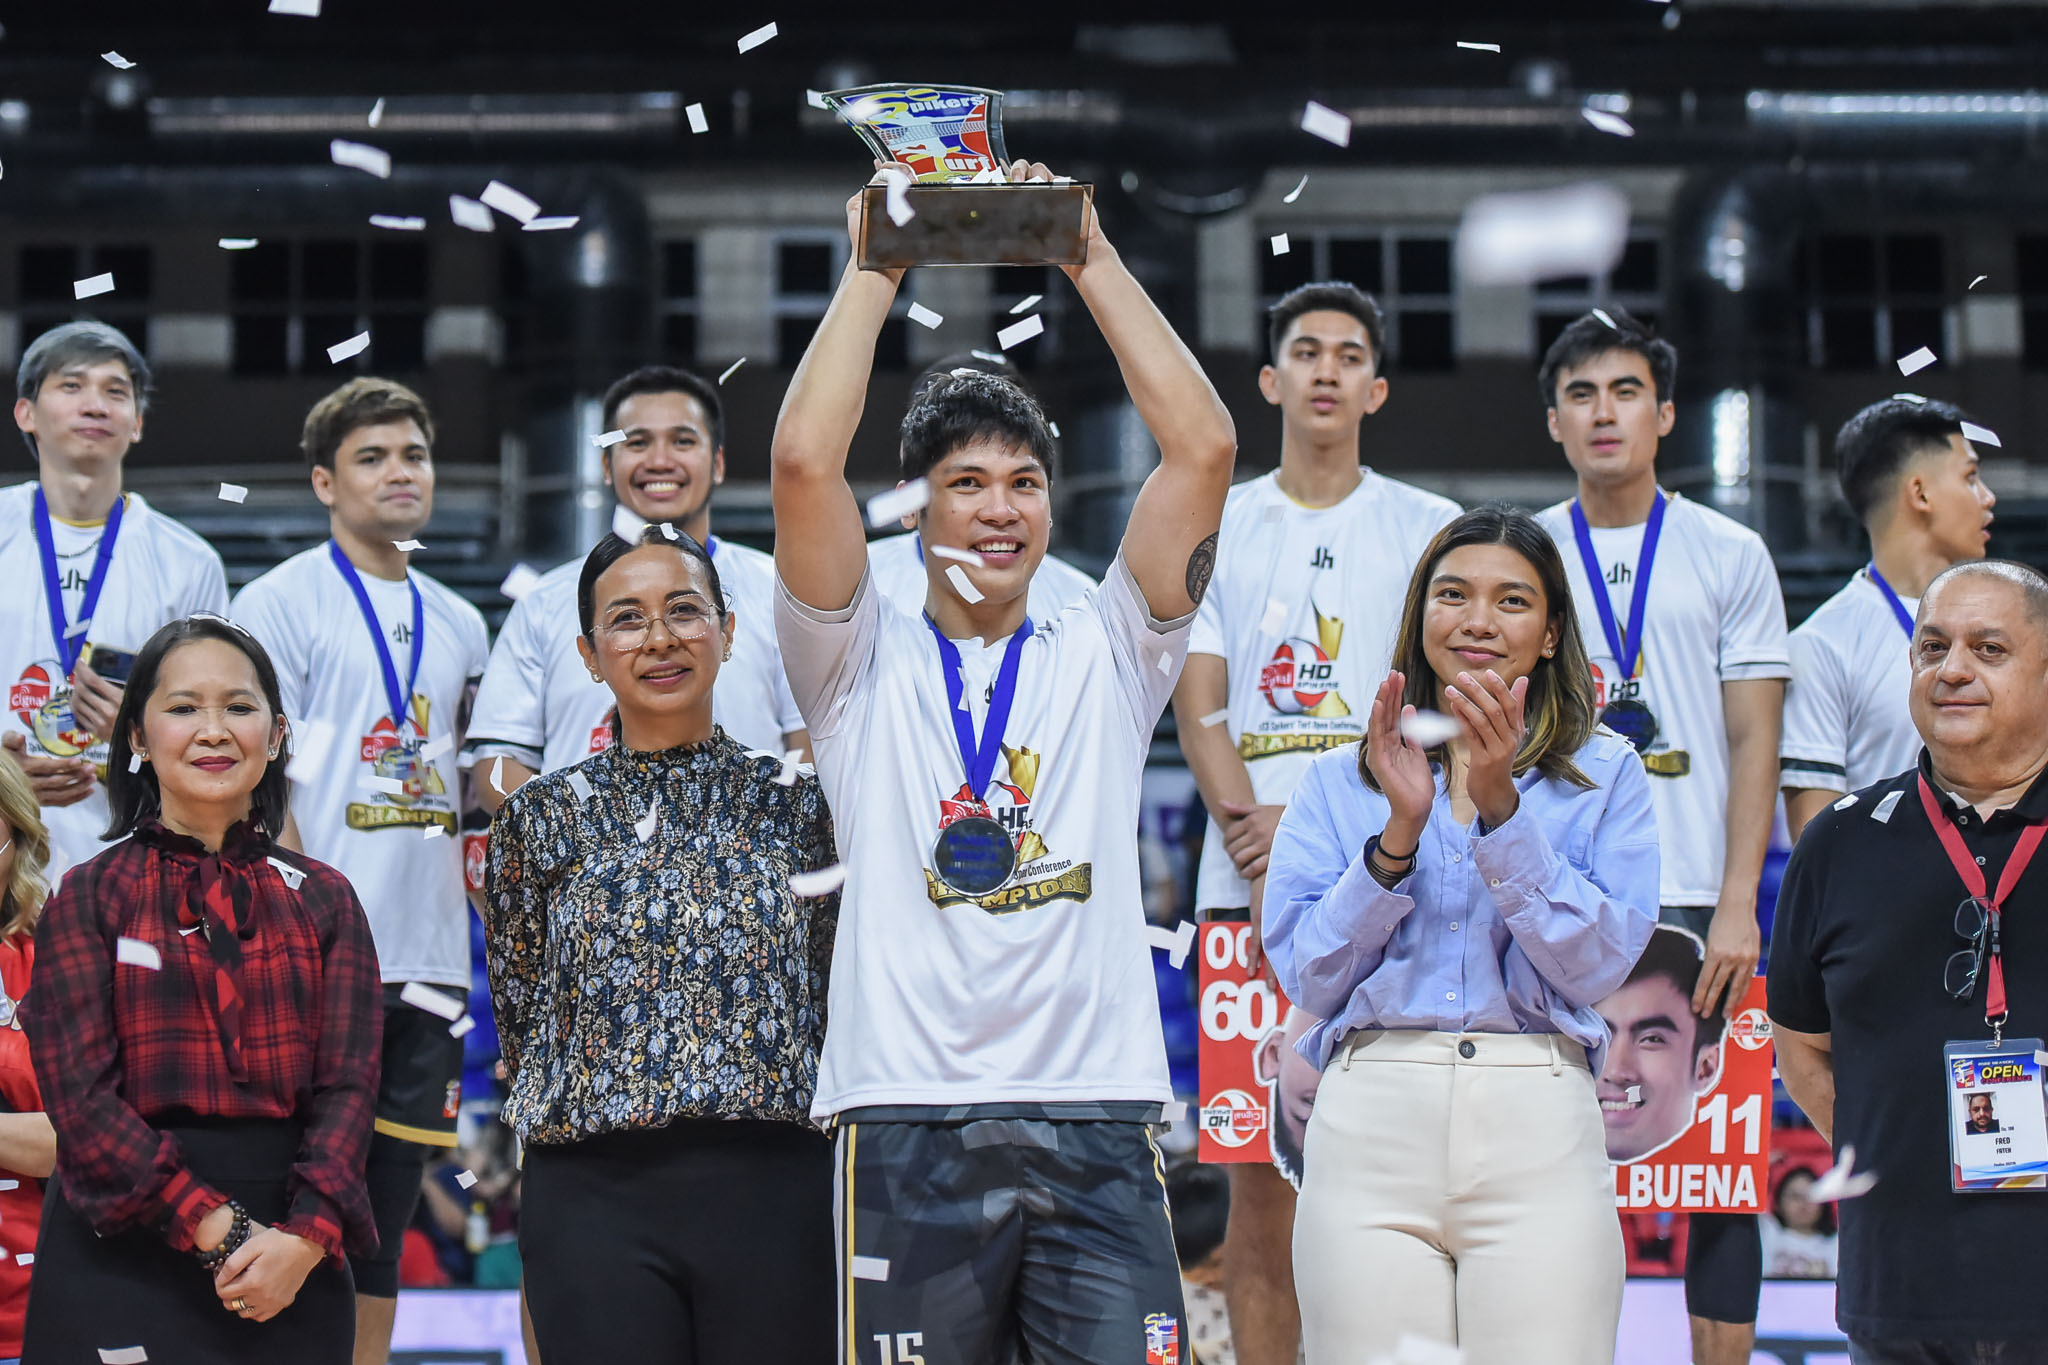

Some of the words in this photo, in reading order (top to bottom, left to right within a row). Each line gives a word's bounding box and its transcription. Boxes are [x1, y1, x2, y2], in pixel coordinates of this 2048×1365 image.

[1299, 664, 1332, 680] HD
[1981, 1065, 2023, 1079] OPEN
[1698, 1094, 1762, 1154] 11
[1995, 1137, 2011, 1145] FRED
[1615, 1165, 1758, 1208] LBUENA
[873, 1331, 926, 1365] 15
